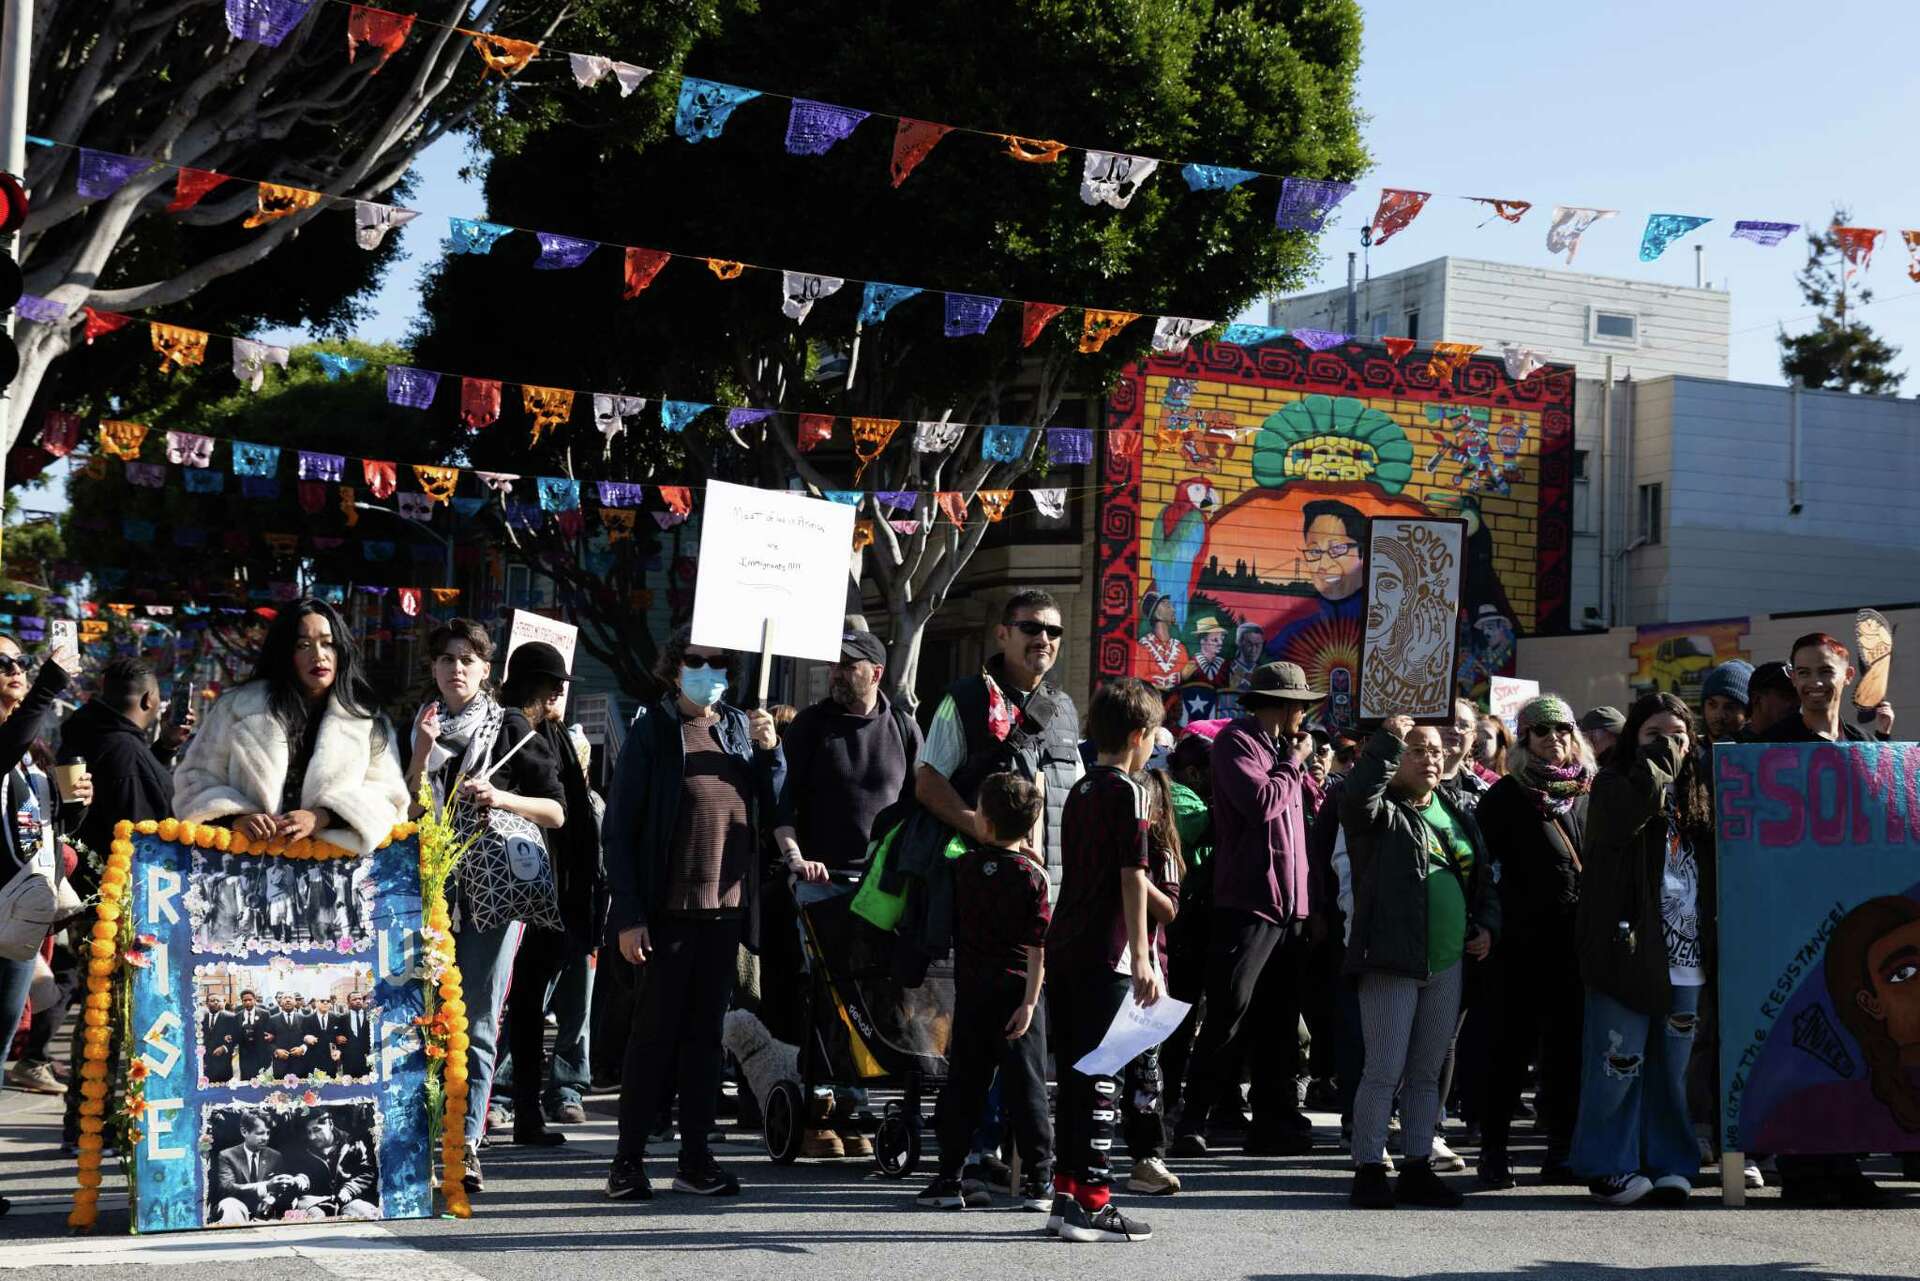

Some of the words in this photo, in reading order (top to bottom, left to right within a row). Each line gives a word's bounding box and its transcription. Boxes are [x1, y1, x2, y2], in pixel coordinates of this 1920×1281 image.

[1397, 525, 1454, 573] SOMOS
[1366, 645, 1447, 706] RESISTENCIA
[1758, 746, 1920, 847] SOM
[1760, 901, 1846, 1020] RESISTANCE!
